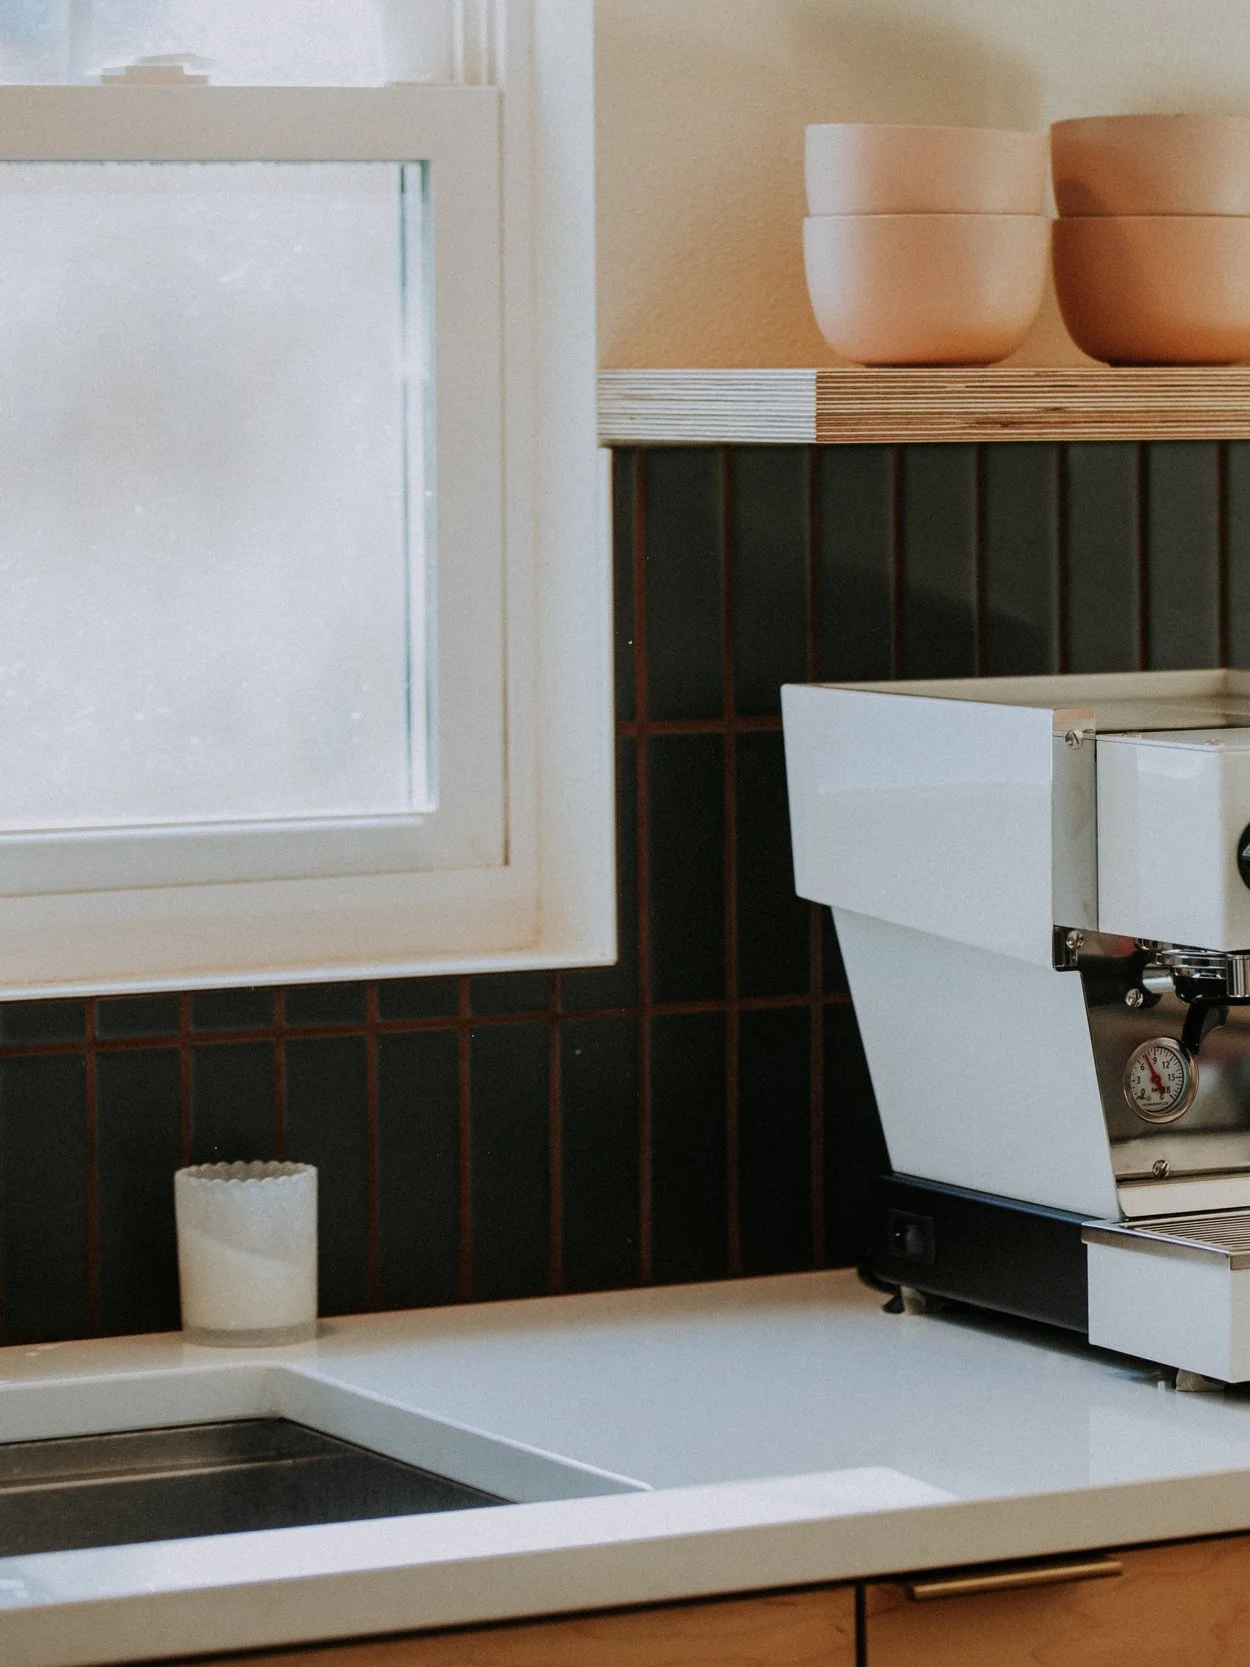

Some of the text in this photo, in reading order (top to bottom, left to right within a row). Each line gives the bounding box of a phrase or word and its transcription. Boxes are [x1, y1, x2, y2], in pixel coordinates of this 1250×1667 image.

[1153, 1057, 1157, 1065] 9
[1162, 1061, 1170, 1069] 12
[1140, 1063, 1145, 1071] 6
[1136, 1076, 1141, 1084] 3
[1168, 1073, 1175, 1082] 15
